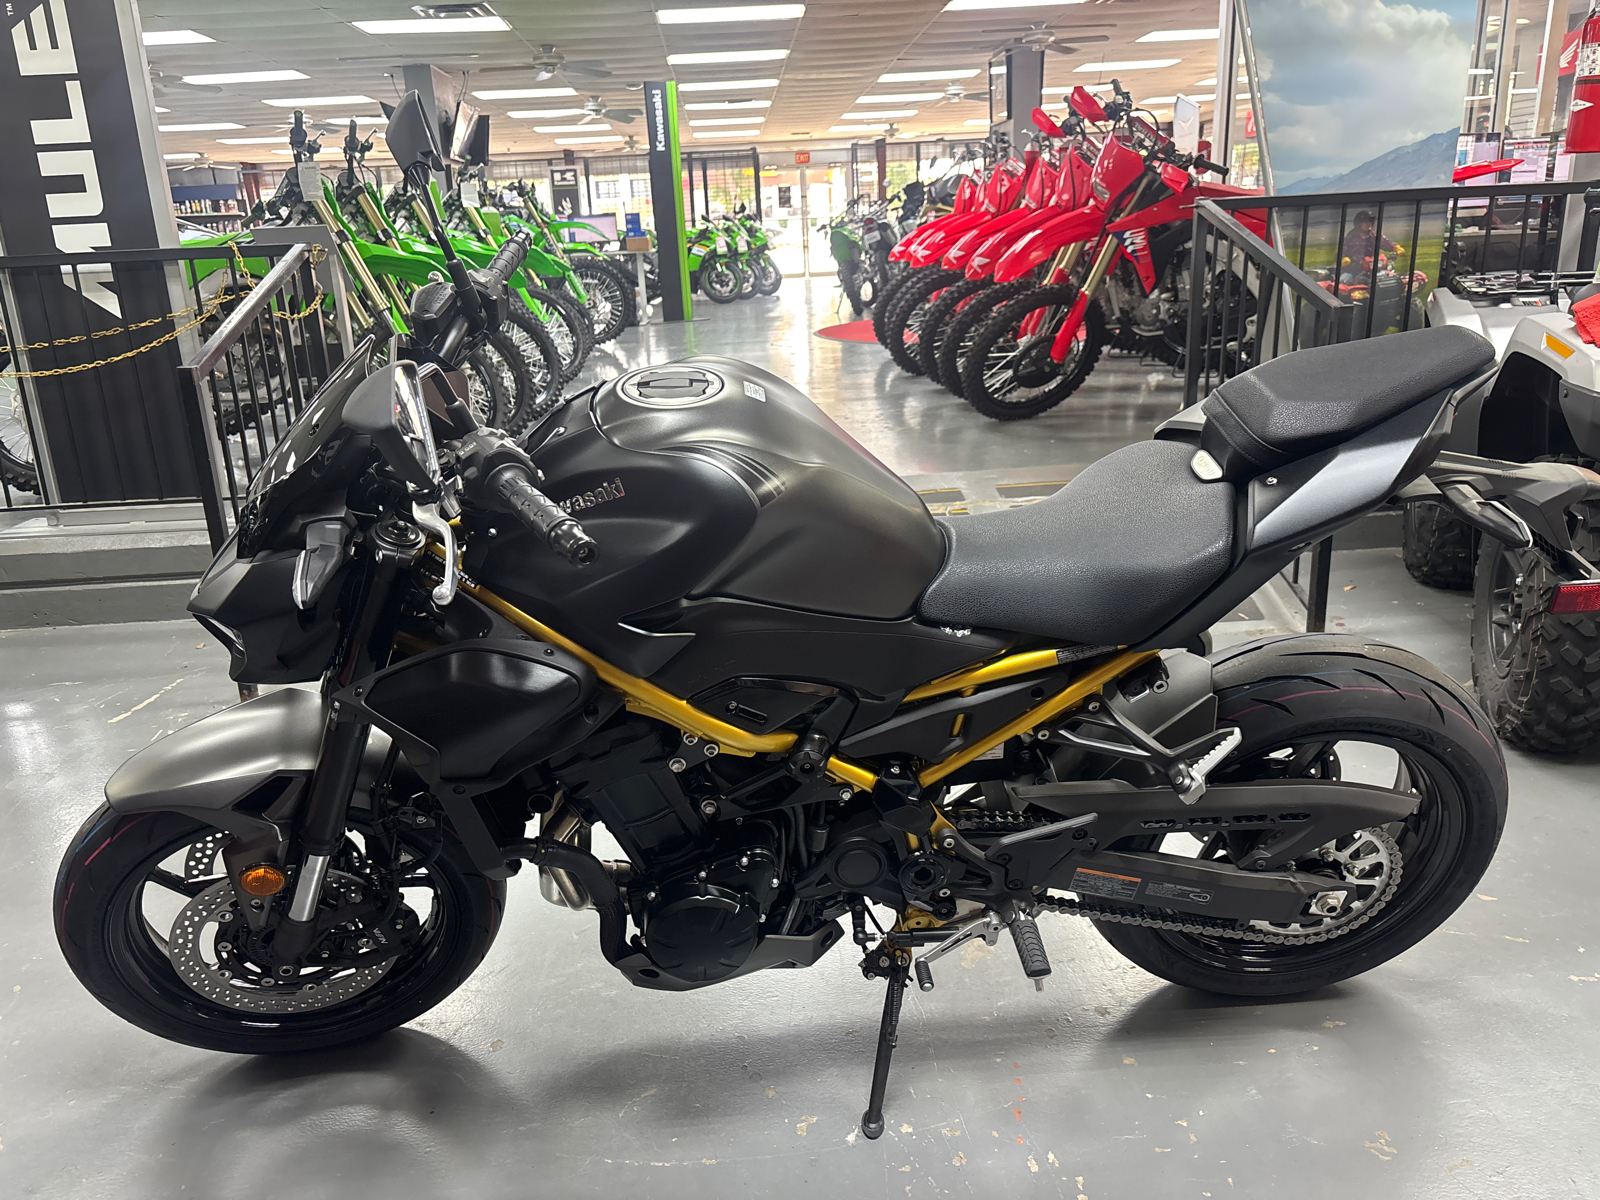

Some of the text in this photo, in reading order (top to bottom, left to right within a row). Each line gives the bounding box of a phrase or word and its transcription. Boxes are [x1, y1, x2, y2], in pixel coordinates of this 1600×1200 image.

[5, 2, 14, 17] TM
[651, 89, 666, 152] Kawasaki
[11, 0, 122, 319] MULE
[557, 477, 626, 514] wasaki
